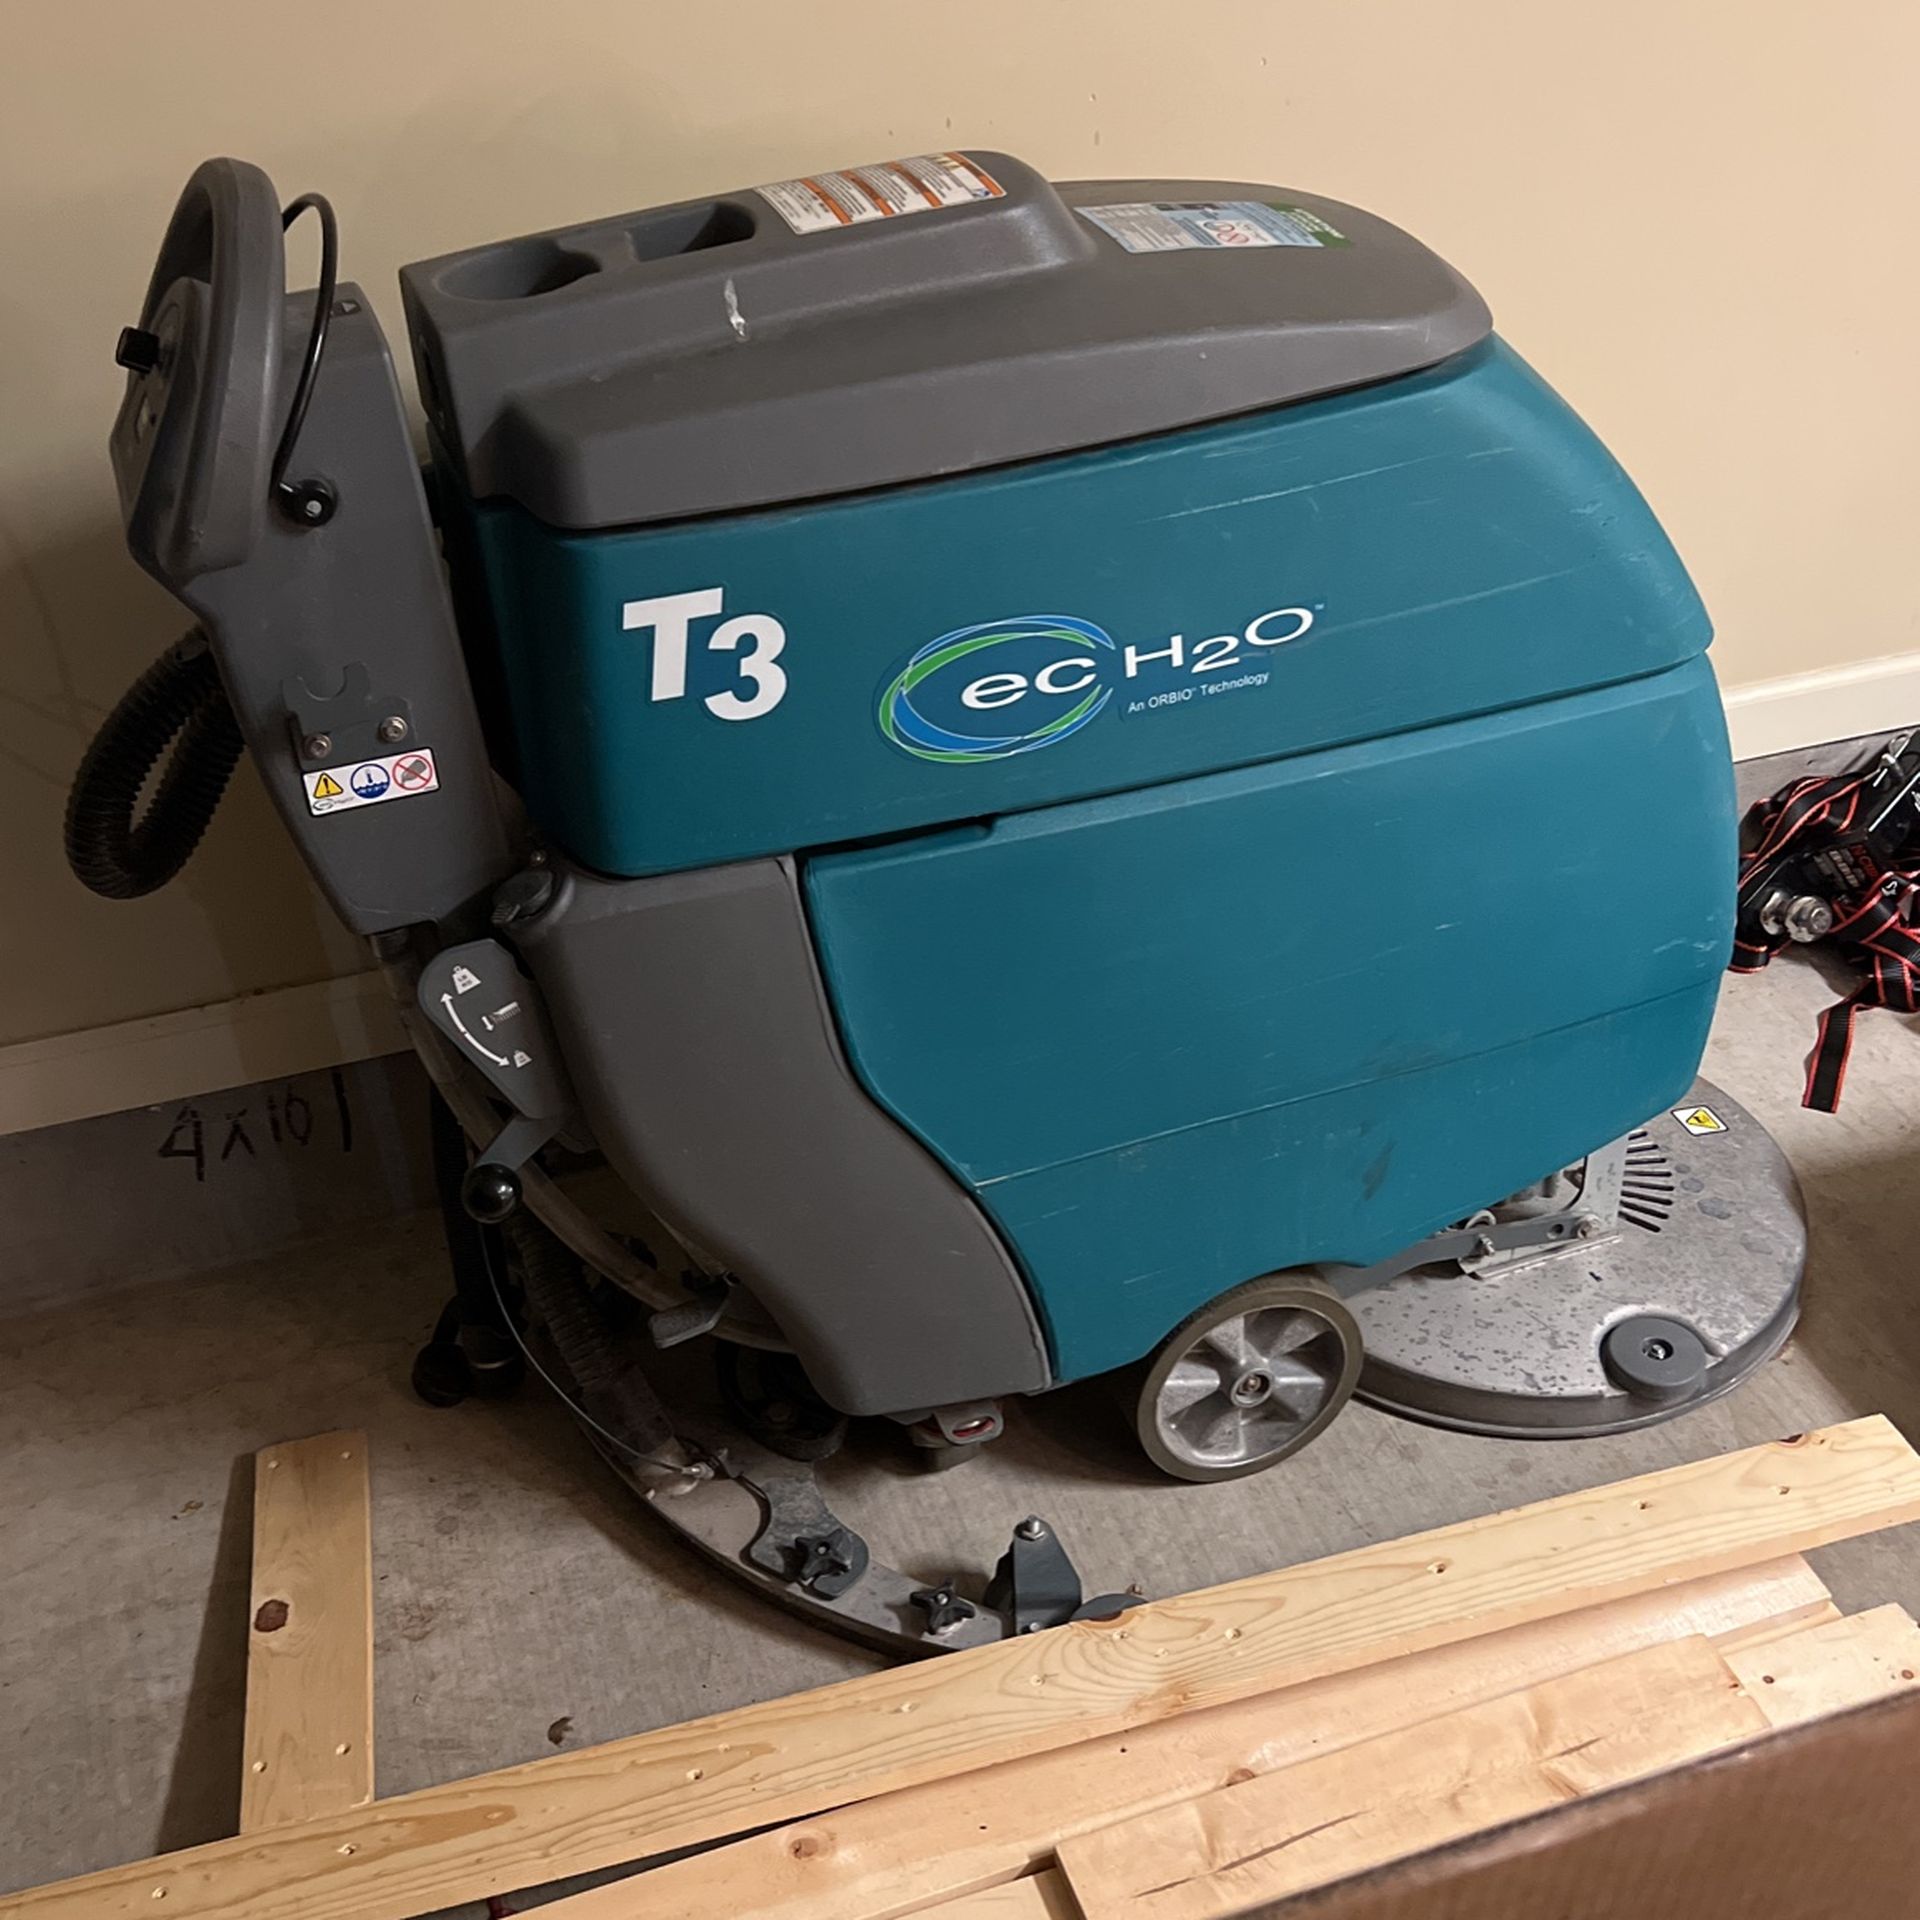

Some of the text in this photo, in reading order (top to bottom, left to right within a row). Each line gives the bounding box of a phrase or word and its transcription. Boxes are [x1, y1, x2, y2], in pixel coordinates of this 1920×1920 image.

[622, 587, 787, 721] T3
[1128, 701, 1145, 713] An
[1200, 672, 1269, 696] Technology
